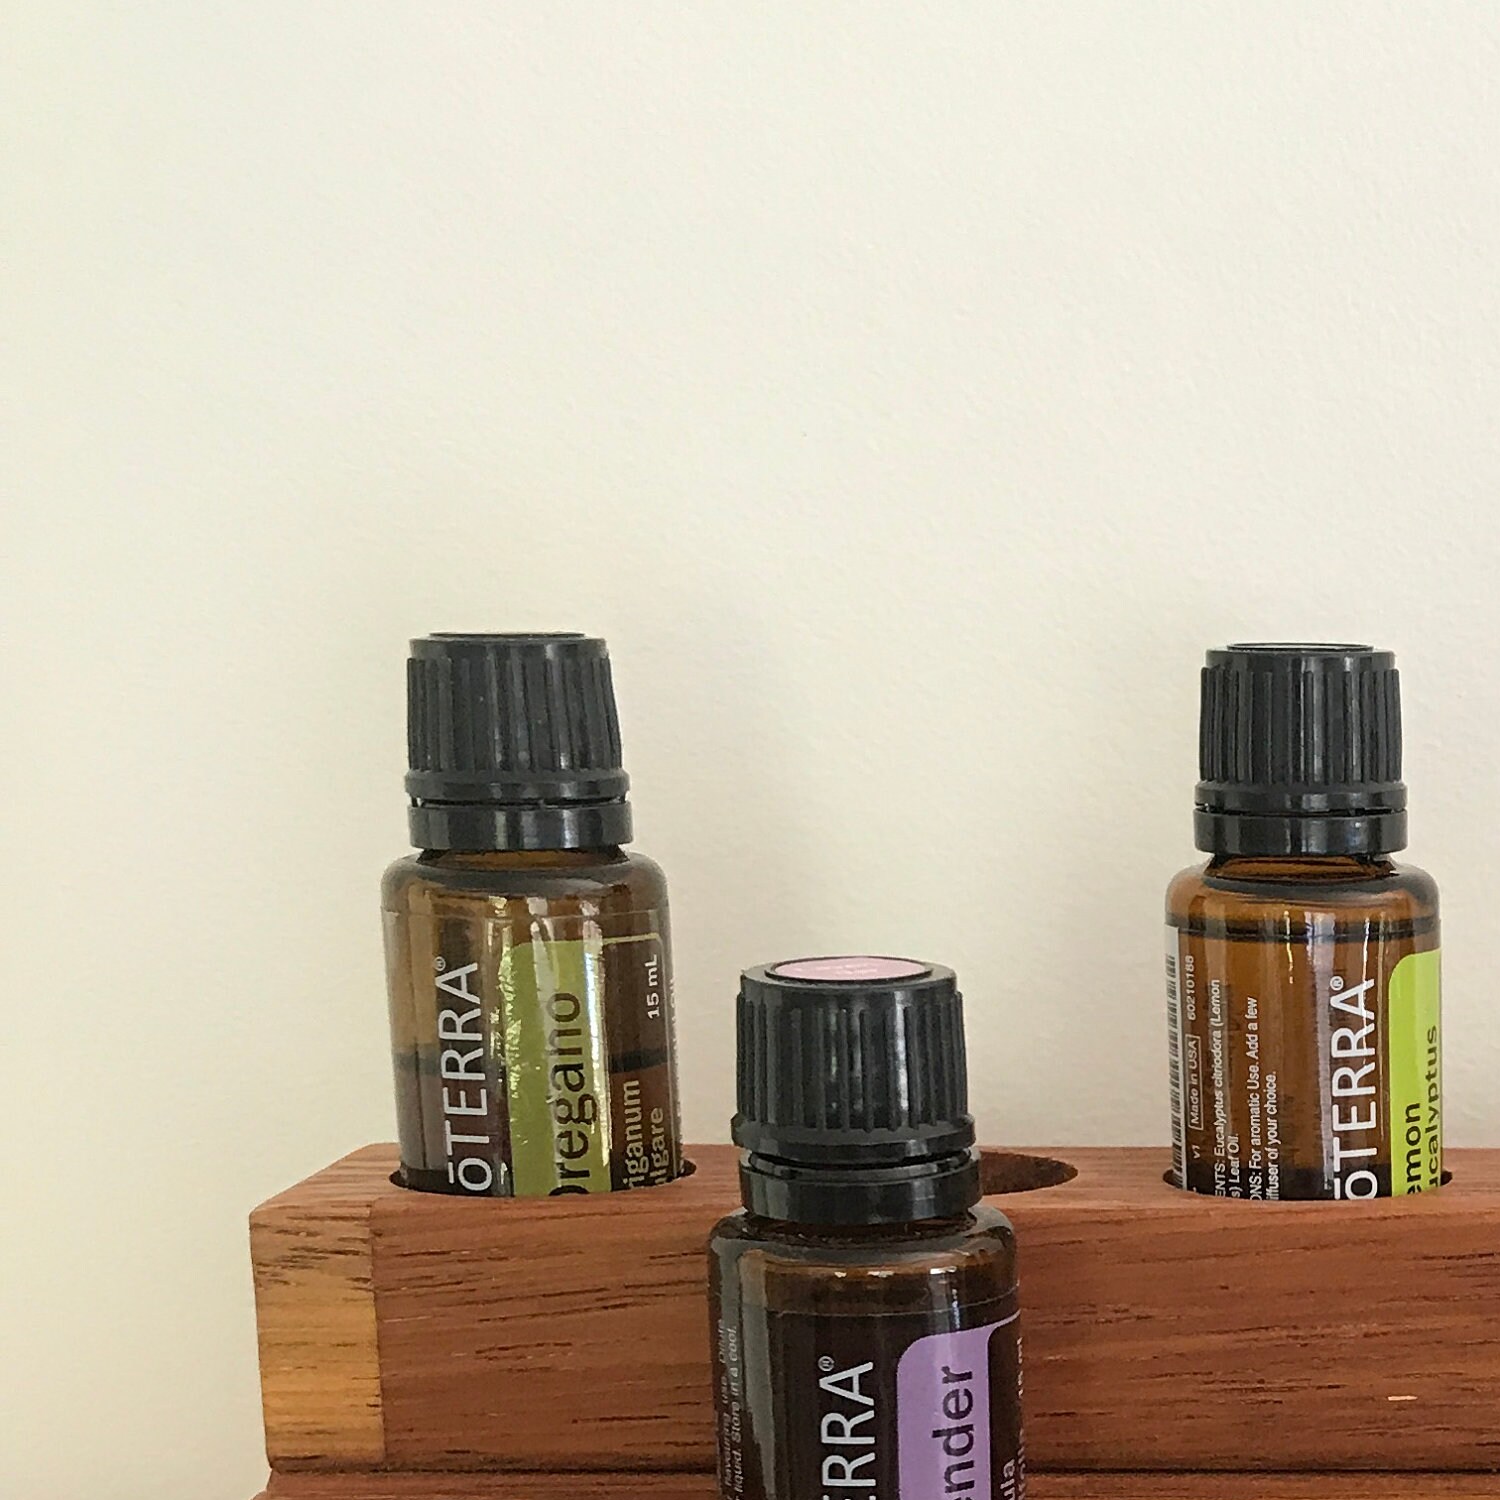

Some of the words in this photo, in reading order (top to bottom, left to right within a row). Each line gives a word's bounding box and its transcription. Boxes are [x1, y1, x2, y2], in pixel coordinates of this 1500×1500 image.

[643, 953, 659, 986] mL
[647, 998, 661, 1020] 15
[1208, 979, 1223, 1027] (Lemon
[1244, 997, 1258, 1019] few
[1247, 1022, 1258, 1032] a
[1187, 1039, 1199, 1071] USA
[1210, 1030, 1223, 1088] citriodora
[1245, 1034, 1259, 1060] Add
[1188, 1072, 1198, 1086] in
[1247, 1062, 1260, 1090] Use.
[1189, 1087, 1200, 1125] Made
[1264, 1071, 1278, 1116] choice.
[1212, 1091, 1228, 1157] Eucalyptus
[1247, 1092, 1261, 1147] aromatic
[1266, 1117, 1281, 1146] your
[1227, 1133, 1240, 1154] Oil.
[1264, 1146, 1279, 1160] of
[1227, 1156, 1240, 1184] Leaf
[1248, 1149, 1262, 1170] For
